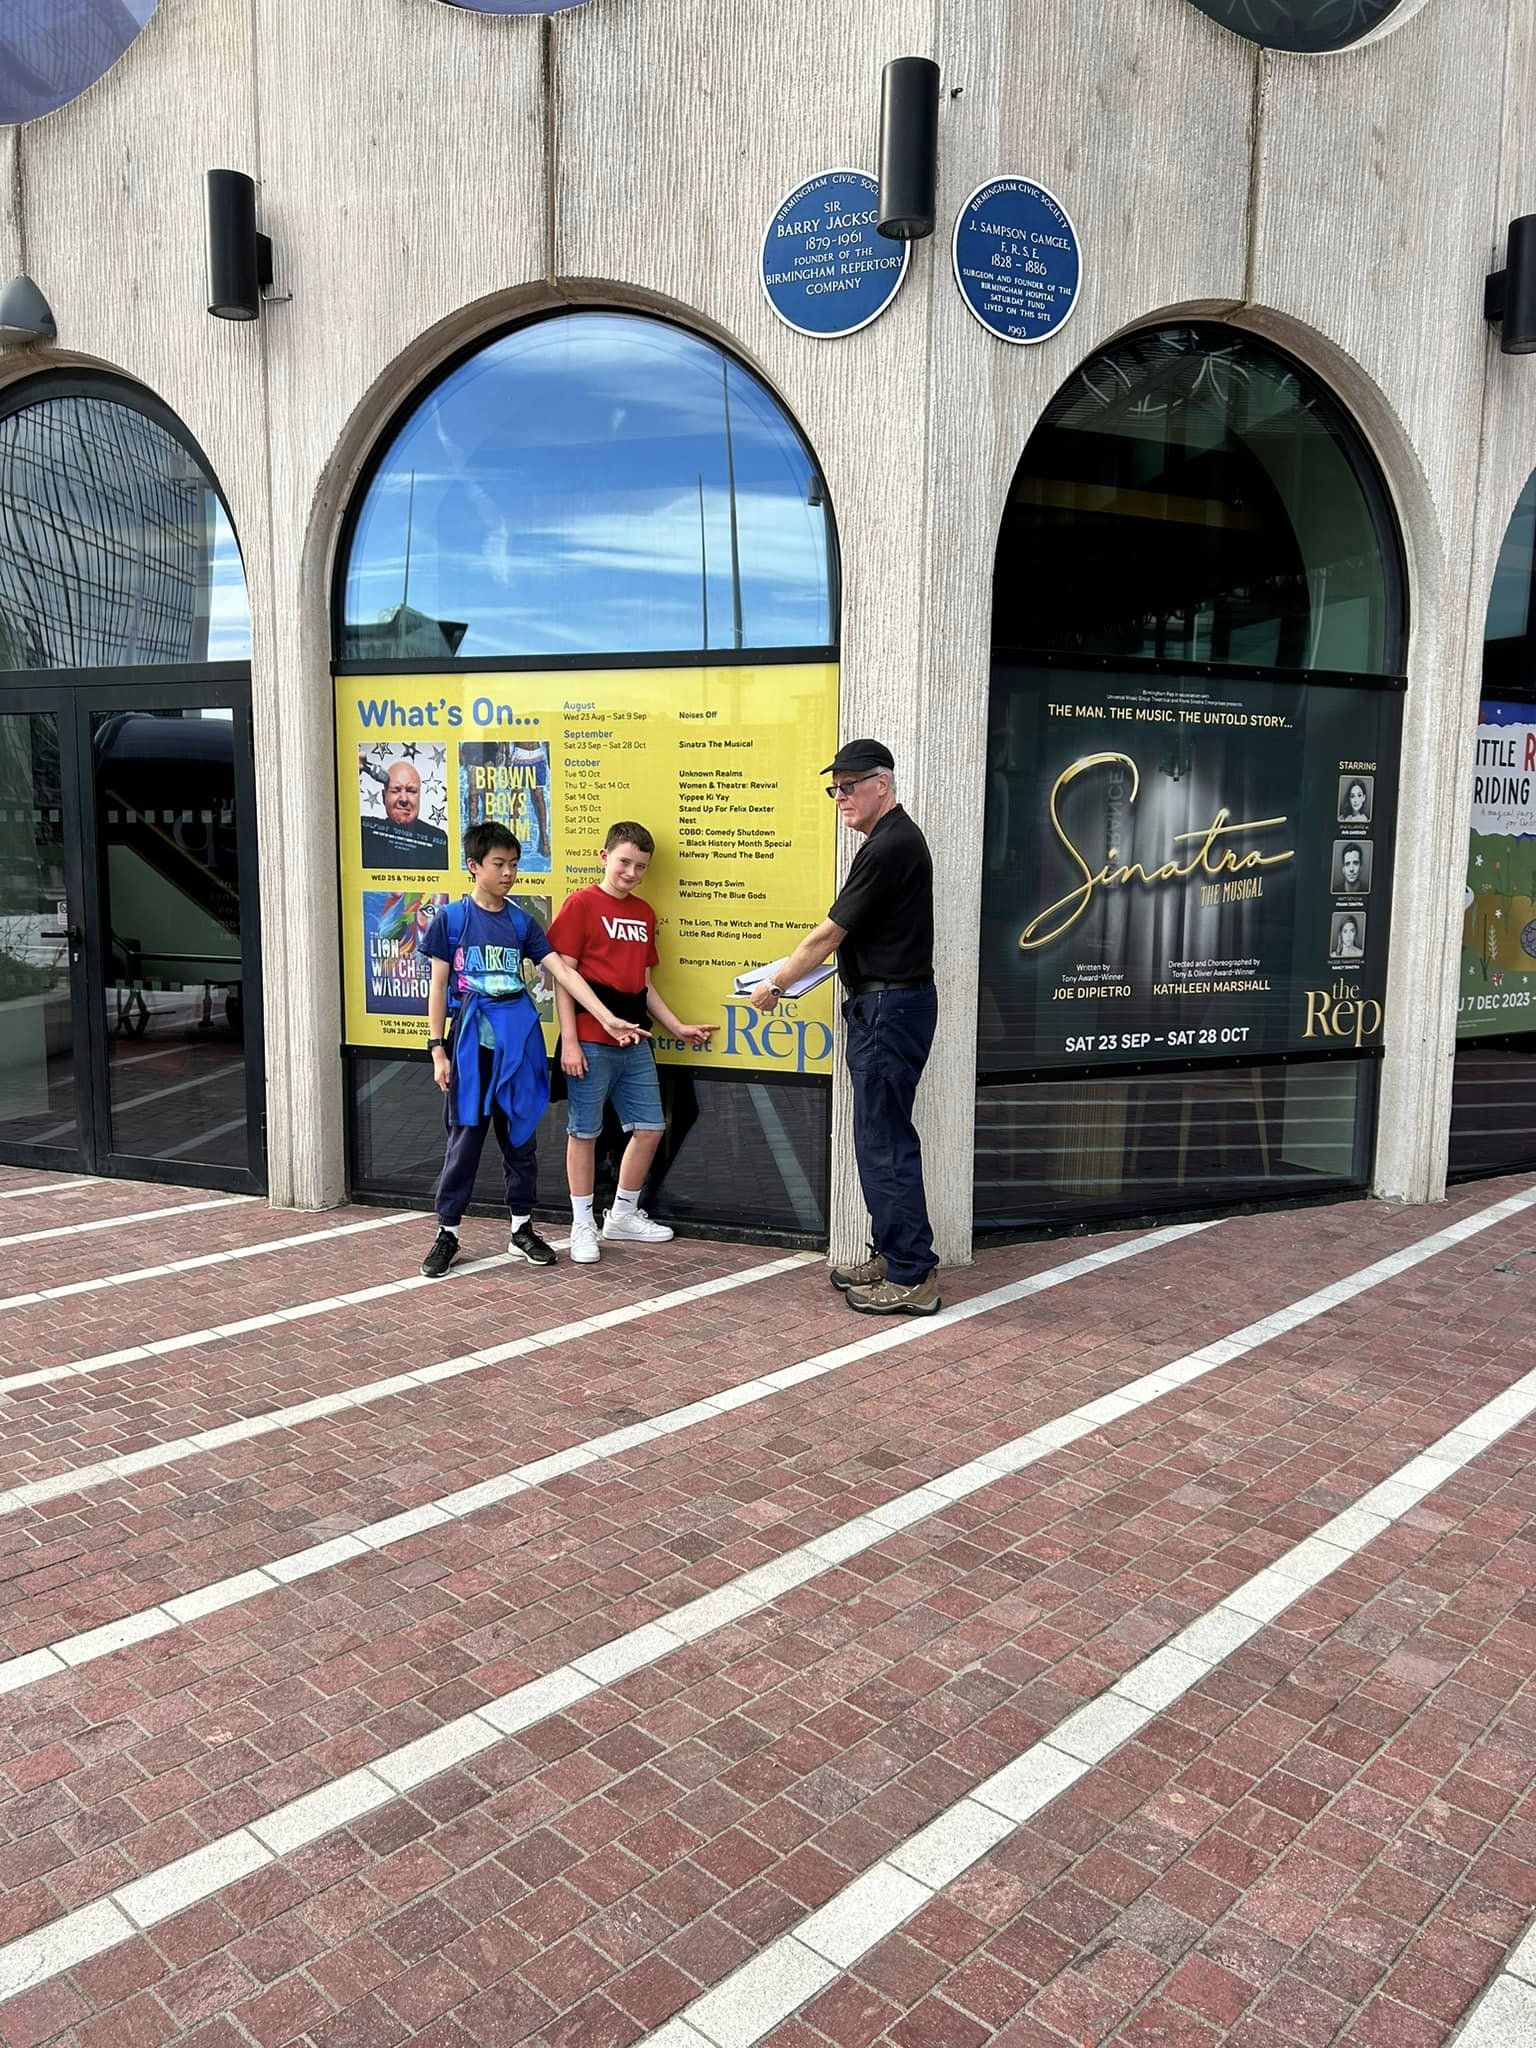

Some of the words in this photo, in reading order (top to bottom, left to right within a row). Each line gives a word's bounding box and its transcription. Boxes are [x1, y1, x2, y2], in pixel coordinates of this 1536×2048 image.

[777, 178, 828, 222] BIRMINGHAM
[832, 174, 857, 185] CIVIC
[824, 200, 842, 213] SIR
[971, 182, 1017, 212] BIRMINGHAM
[1018, 183, 1041, 199] CIVIC
[1041, 194, 1069, 229] SOCIETY
[777, 218, 821, 238] BARRY
[969, 220, 977, 231] J.
[980, 222, 1027, 240] SAMPSON
[1030, 232, 1071, 250] GAMGEE,
[805, 232, 862, 250] 1879-1961
[794, 252, 834, 266] FOUNDER
[838, 250, 850, 260] OF
[855, 246, 874, 257] THE
[1002, 242, 1008, 254] F.
[1011, 244, 1020, 256] R.
[1022, 246, 1030, 258] S.
[1032, 248, 1040, 260] E.
[766, 265, 835, 286] BIRMINGHAM
[840, 256, 904, 275] REPERTORY
[991, 253, 1012, 269] 1828
[1025, 260, 1048, 276] 1886
[805, 277, 862, 296] COMPANY
[962, 268, 994, 281] SURGEON
[997, 274, 1012, 284] AND
[1014, 276, 1044, 290] FOUNDER
[1048, 284, 1056, 292] OF
[1058, 286, 1072, 296] THE
[980, 282, 1023, 296] BIRMINGHAM
[1025, 290, 1055, 302] HOSPITAL
[990, 293, 1024, 306] SATURDAY
[1028, 300, 1046, 310] FUND
[984, 303, 1004, 313] LIVED
[1006, 306, 1017, 316] ON
[1020, 310, 1034, 319] THIS
[1037, 312, 1051, 322] SITE
[1007, 324, 1026, 338] 1993
[357, 698, 463, 728] What's
[564, 701, 596, 712] August
[591, 713, 606, 722] Aug
[613, 712, 625, 720] Sat
[626, 712, 632, 720] 9
[633, 712, 647, 721] Sep
[1048, 703, 1073, 718] THE
[1075, 705, 1107, 719] MAN.
[1109, 707, 1134, 720] THE
[1136, 708, 1176, 722] MUSIC.
[1178, 710, 1201, 724] THE
[1203, 711, 1248, 726] UNTOLD
[1250, 714, 1294, 729] STORY...
[564, 729, 614, 740] September
[564, 742, 576, 750] Sat
[577, 742, 586, 750] 23
[588, 742, 601, 750] Sep
[608, 742, 621, 750] Sat
[622, 741, 632, 749] 28
[634, 741, 646, 749] Oct
[679, 740, 706, 748] Sinatra
[708, 740, 722, 748] The
[724, 740, 753, 748] Musical
[1476, 738, 1516, 768] ITTLE
[564, 758, 600, 768] October
[1339, 760, 1377, 771] STARRING
[476, 766, 537, 790] BROWN
[679, 770, 714, 778] Unknown
[715, 770, 743, 778] Realms
[679, 793, 704, 802] Yippee
[716, 793, 730, 802] Yay
[1474, 776, 1530, 806] RIDING
[486, 792, 528, 816] BOYS
[703, 805, 714, 814] Up
[705, 828, 736, 838] Comedy
[737, 828, 776, 836] Shutdown
[679, 851, 710, 859] Halfway
[1018, 752, 1295, 950] Sinatra
[704, 880, 723, 888] Boys
[1200, 885, 1220, 907] THE
[1222, 876, 1264, 903] MUSICAL
[679, 891, 712, 900] Waltzing
[748, 892, 766, 900] Gods
[601, 915, 649, 944] VANS
[718, 932, 740, 940] Riding
[742, 932, 762, 940] Hood
[370, 938, 399, 958] LION
[1076, 964, 1102, 972] Written
[1102, 963, 1110, 973] by
[1168, 960, 1194, 969] Directed
[1195, 960, 1206, 968] and
[1207, 958, 1252, 969] Choreographed
[1253, 958, 1261, 967] by
[1061, 974, 1078, 984] Tony
[1078, 972, 1124, 982] Award-Winner
[1172, 970, 1186, 980] Tony
[1194, 969, 1212, 978] Olivier
[1213, 968, 1256, 978] Award-Winner
[1052, 987, 1074, 1000] JOE
[1077, 985, 1132, 999] DIPIETRO
[1153, 982, 1211, 996] KATHLEEN
[1213, 980, 1271, 993] MARSHALL
[1332, 977, 1360, 1000] the
[1468, 996, 1475, 1011] 7
[1477, 994, 1500, 1010] DEC
[1502, 992, 1530, 1008] 2023
[1301, 990, 1382, 1048] Rep
[720, 1004, 833, 1072] Rep
[1065, 1036, 1095, 1052] SAT
[1098, 1035, 1118, 1051] 23
[1121, 1032, 1151, 1049] SEP
[1167, 1030, 1196, 1046] SAT
[1198, 1028, 1218, 1044] 28
[1220, 1027, 1250, 1043] OCT
